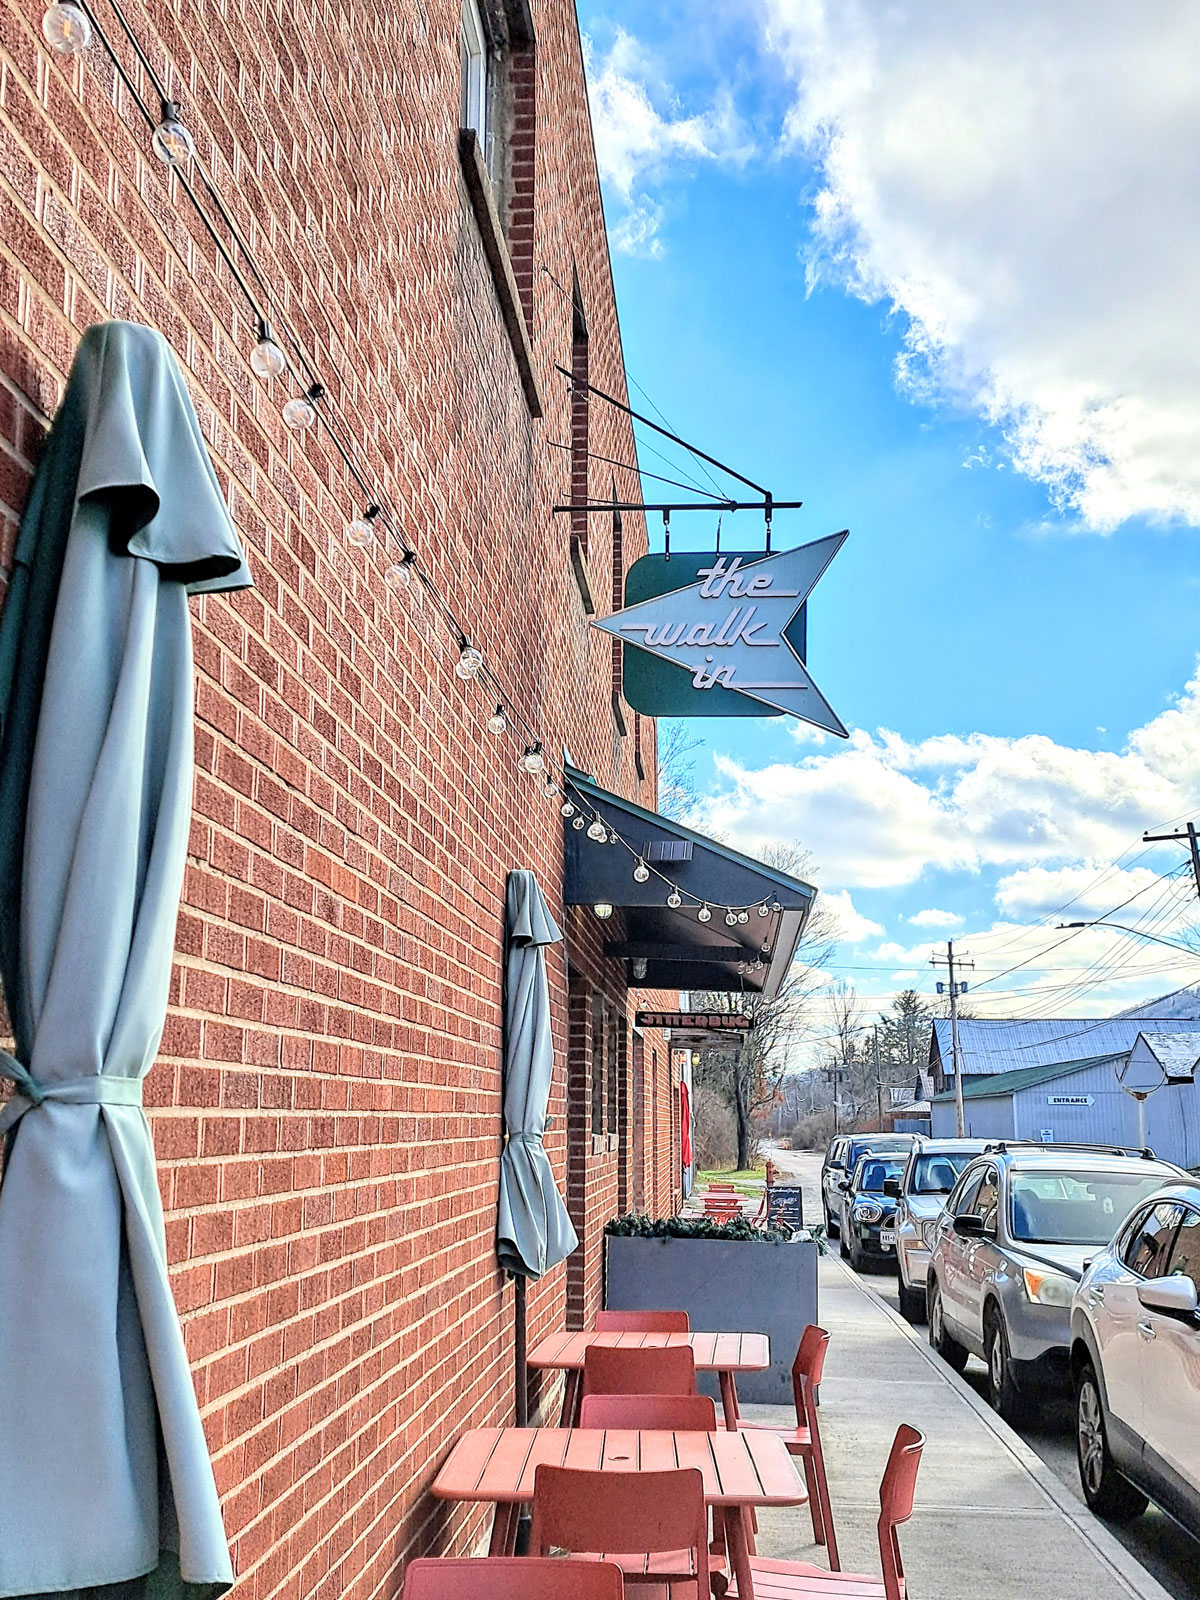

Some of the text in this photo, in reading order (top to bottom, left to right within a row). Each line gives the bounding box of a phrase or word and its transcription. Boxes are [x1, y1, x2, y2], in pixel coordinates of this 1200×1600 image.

[696, 556, 800, 599] the
[620, 606, 780, 647] walk
[641, 1014, 749, 1028] JITTERBUG
